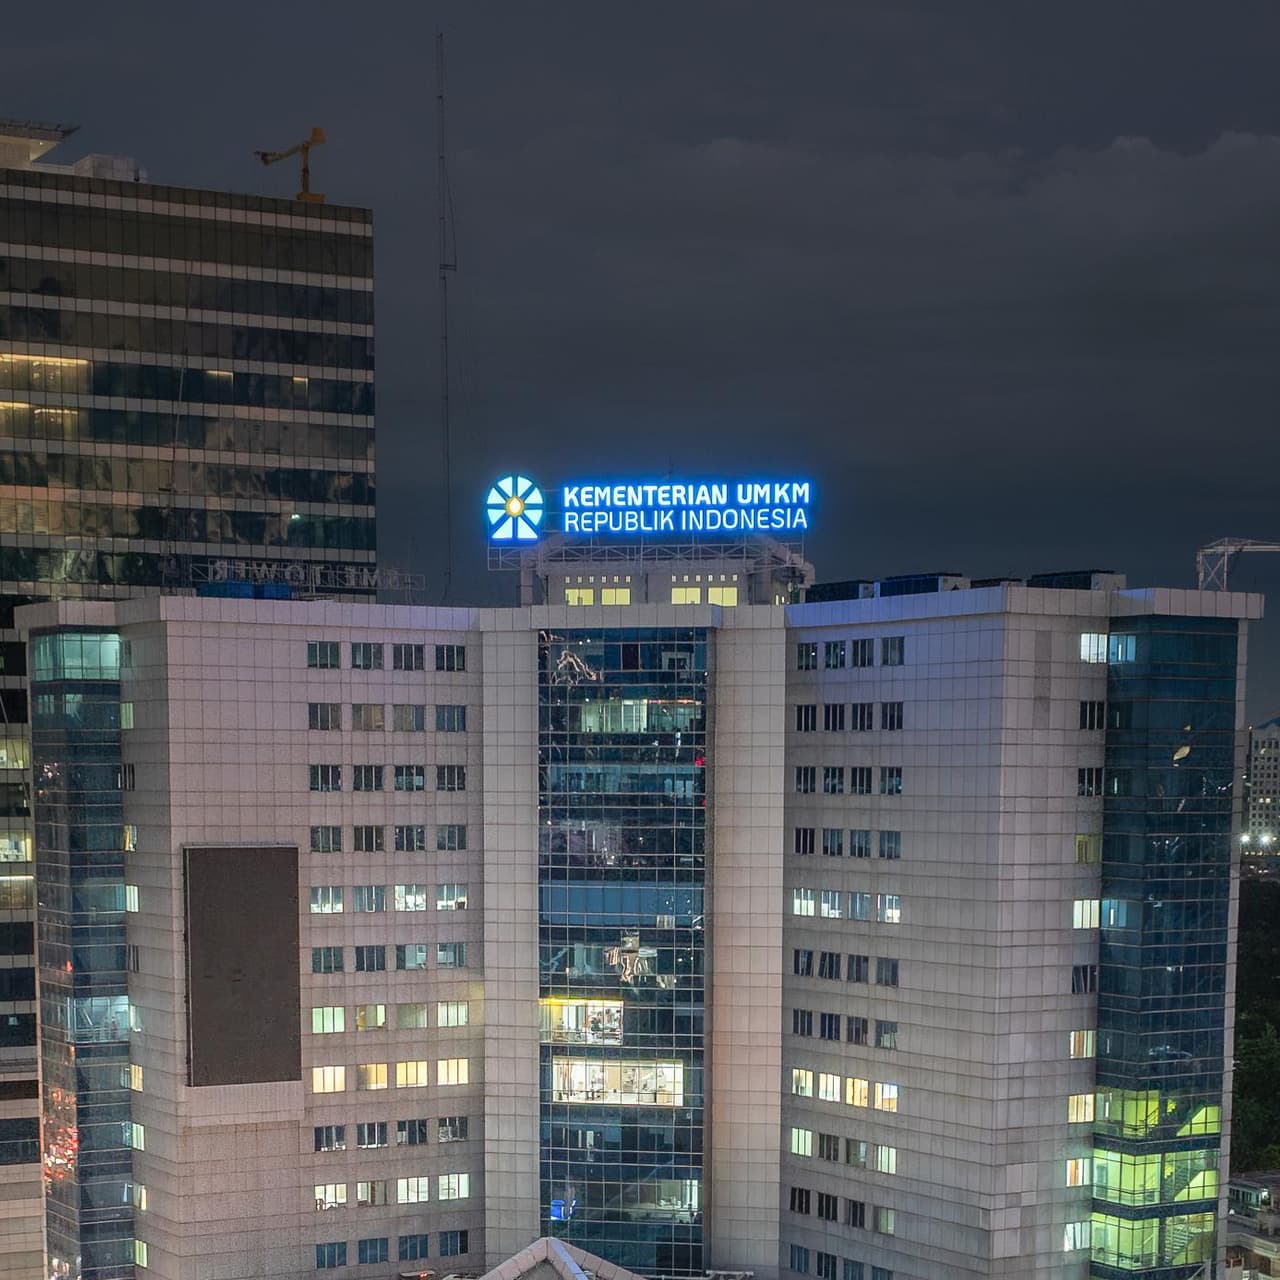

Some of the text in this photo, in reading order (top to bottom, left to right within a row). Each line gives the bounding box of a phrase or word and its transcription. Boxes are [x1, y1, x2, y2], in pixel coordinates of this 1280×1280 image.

[564, 482, 810, 507] KEMENTERIAN UMKM
[565, 508, 808, 532] REPUBLIK INDONESIA
